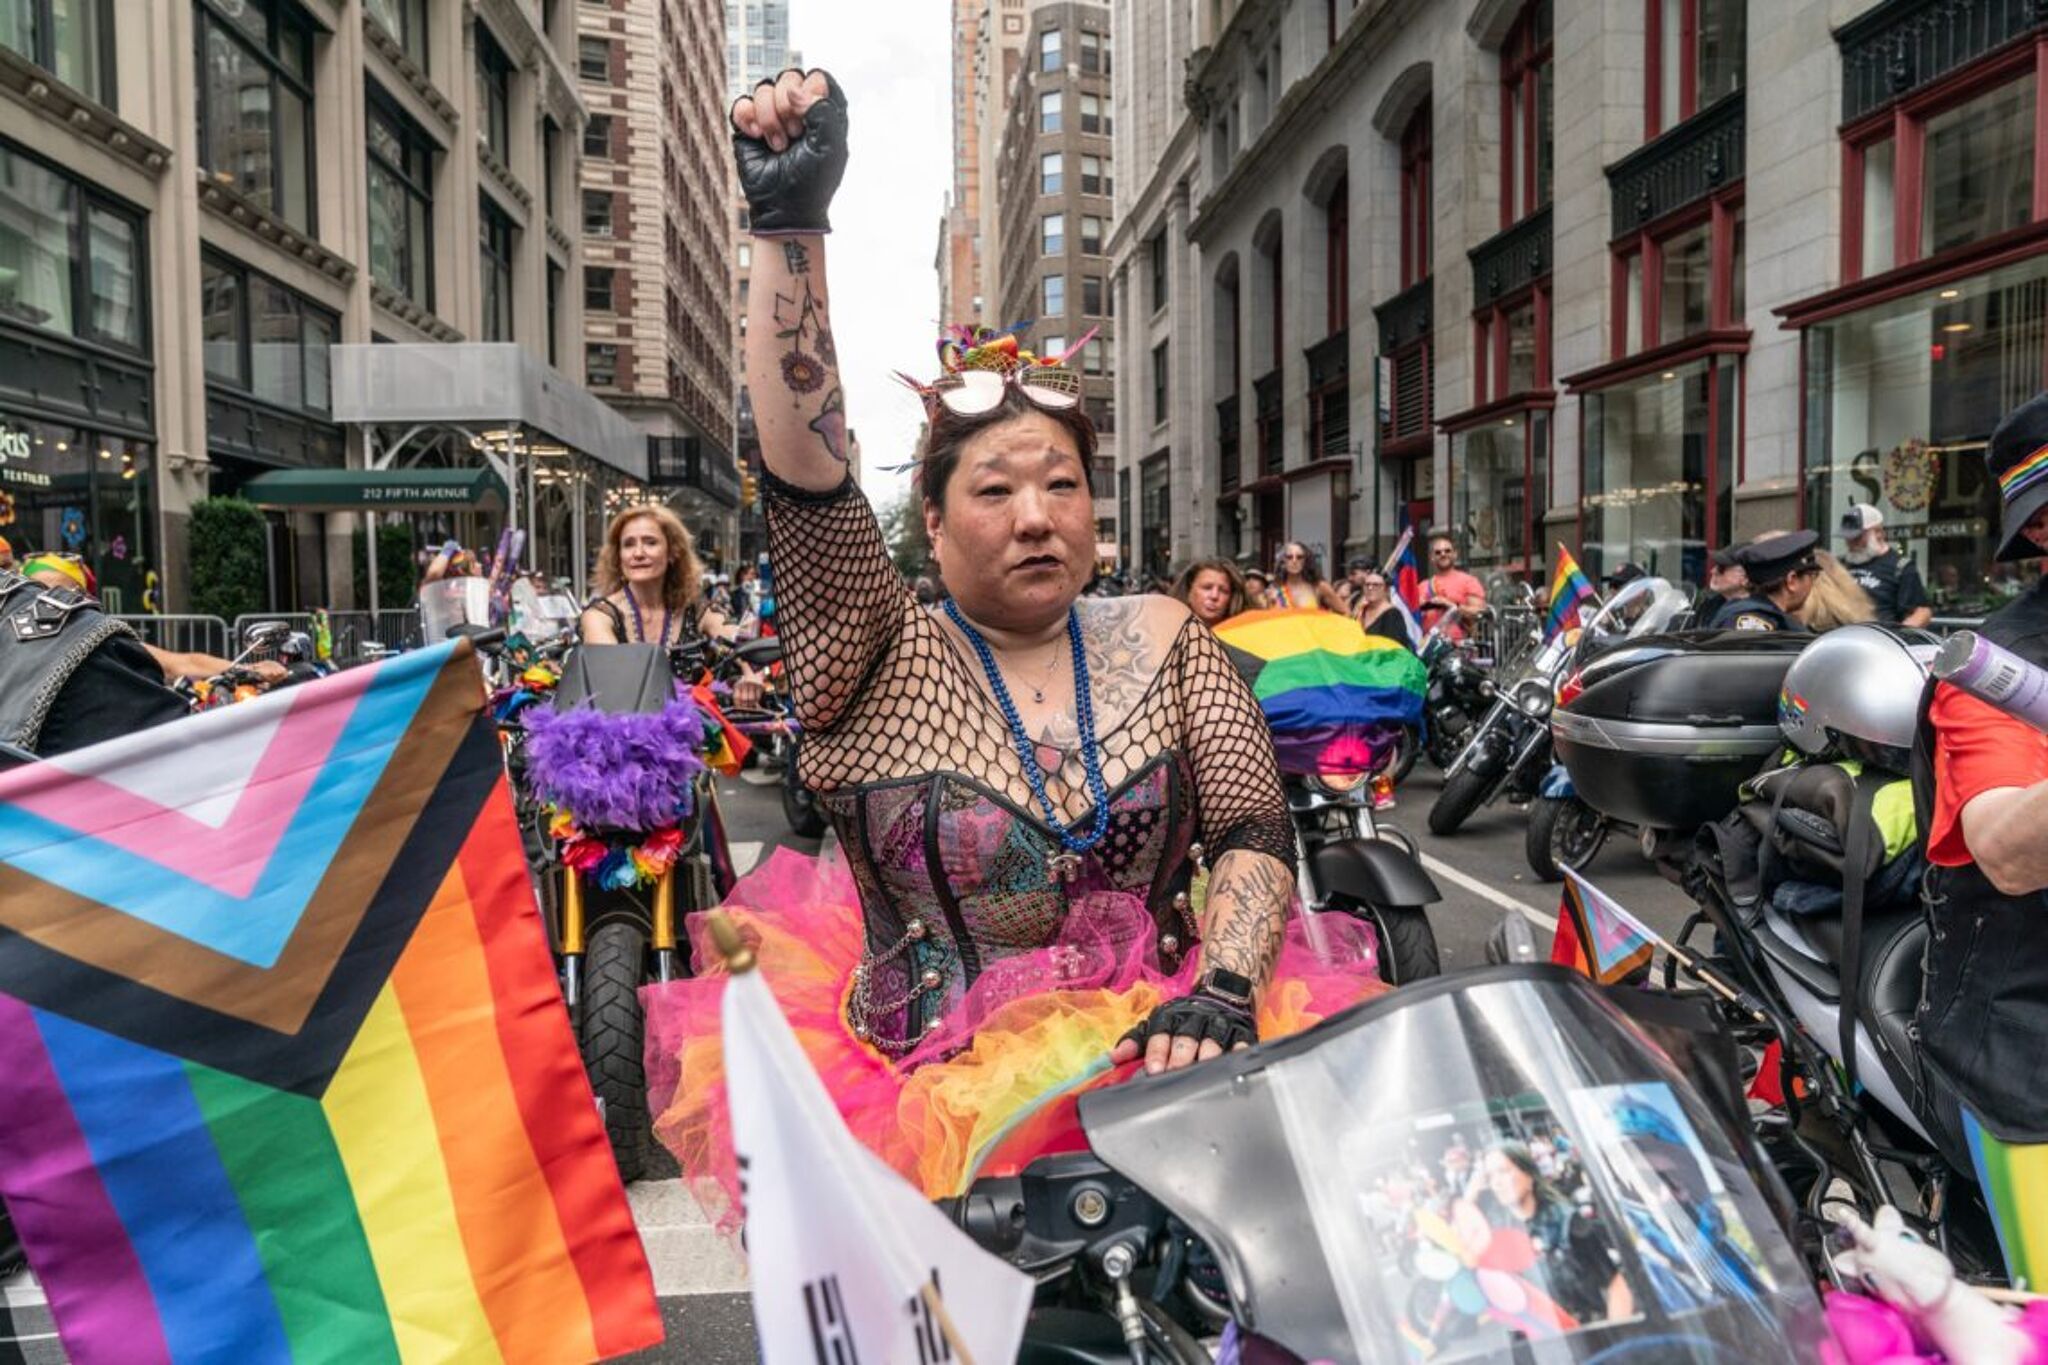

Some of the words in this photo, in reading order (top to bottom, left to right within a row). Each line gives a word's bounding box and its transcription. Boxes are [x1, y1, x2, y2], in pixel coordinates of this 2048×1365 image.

[3, 469, 51, 487] TEXTILES
[363, 487, 383, 499] 212
[385, 487, 419, 499] FIFTH
[422, 487, 470, 499] AVENUE
[1925, 523, 1968, 537] COCINA
